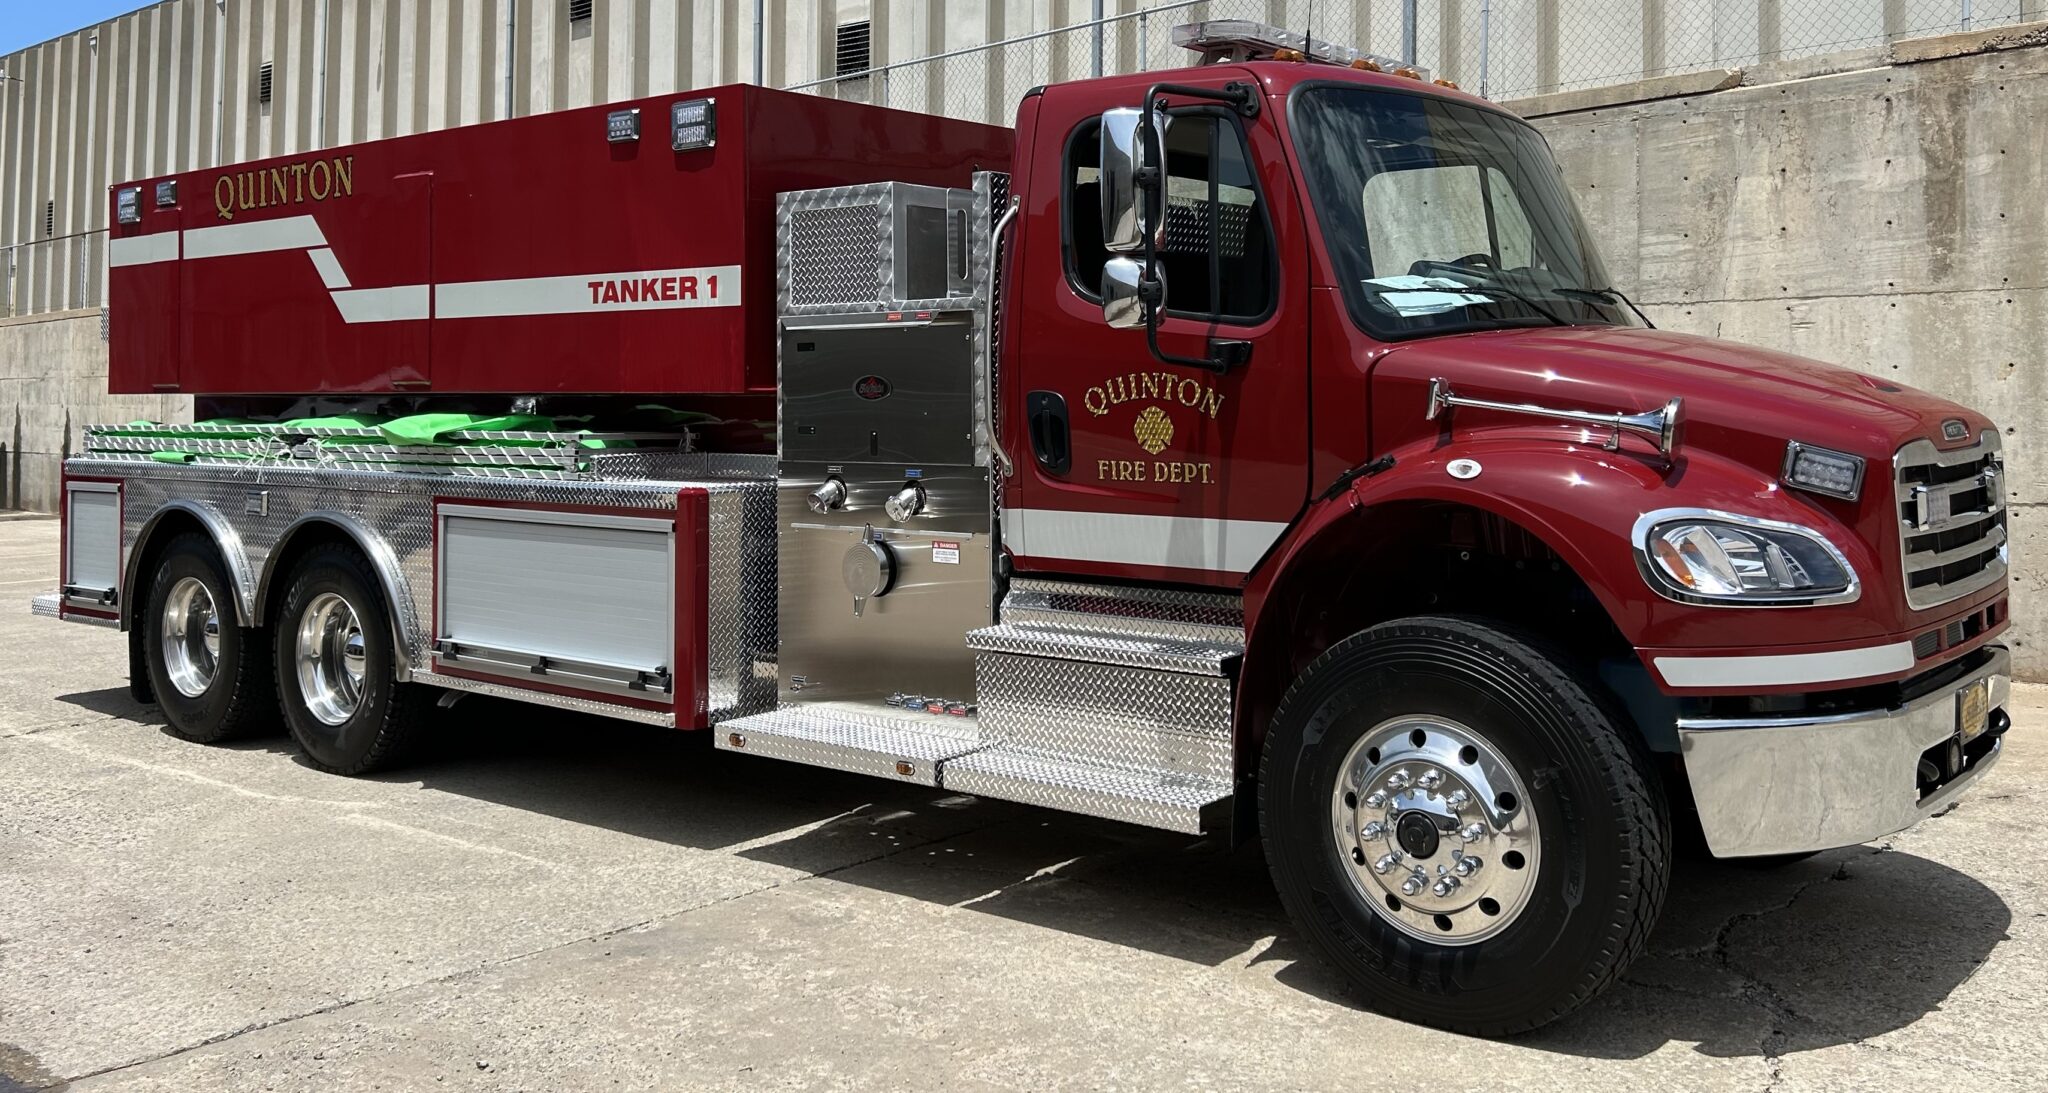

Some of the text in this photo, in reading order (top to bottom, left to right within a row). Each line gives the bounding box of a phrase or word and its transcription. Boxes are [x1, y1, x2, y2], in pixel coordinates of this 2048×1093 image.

[214, 156, 353, 220] QUINTON
[587, 275, 718, 304] TANKER 1
[1084, 372, 1226, 419] QUINTON
[1097, 459, 1215, 484] FIRE DEPT.
